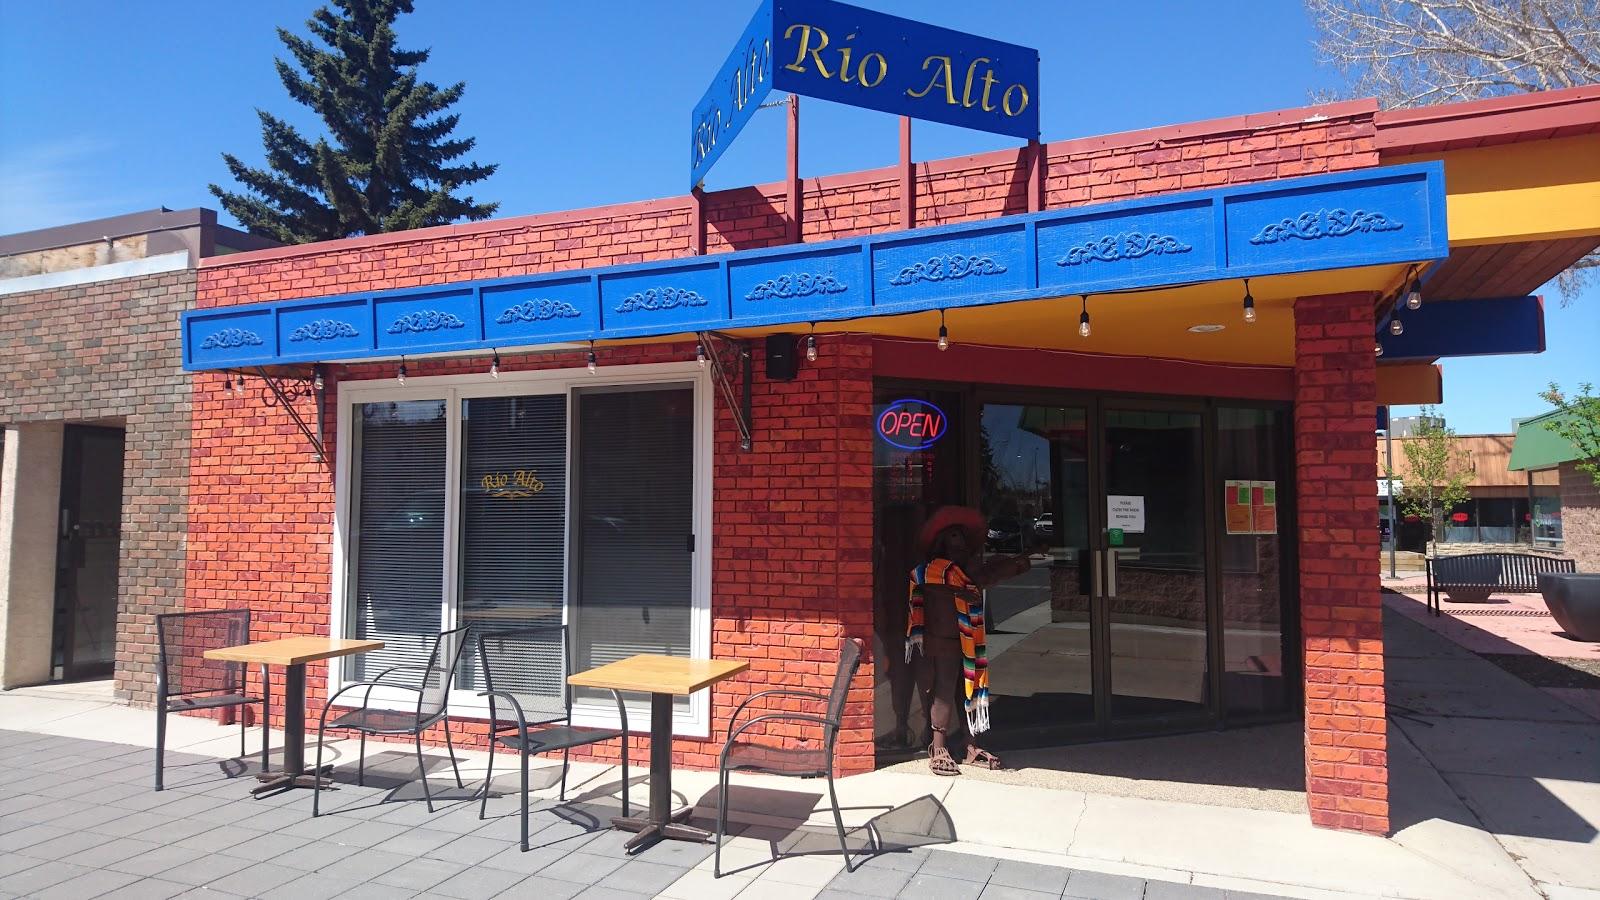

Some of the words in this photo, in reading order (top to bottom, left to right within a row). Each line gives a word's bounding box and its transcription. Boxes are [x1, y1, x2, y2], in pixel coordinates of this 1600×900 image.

[726, 37, 771, 128] Alto
[784, 24, 888, 88] Rio
[907, 56, 1030, 117] Alto
[881, 411, 941, 437] OPEN
[513, 469, 544, 492] Alto
